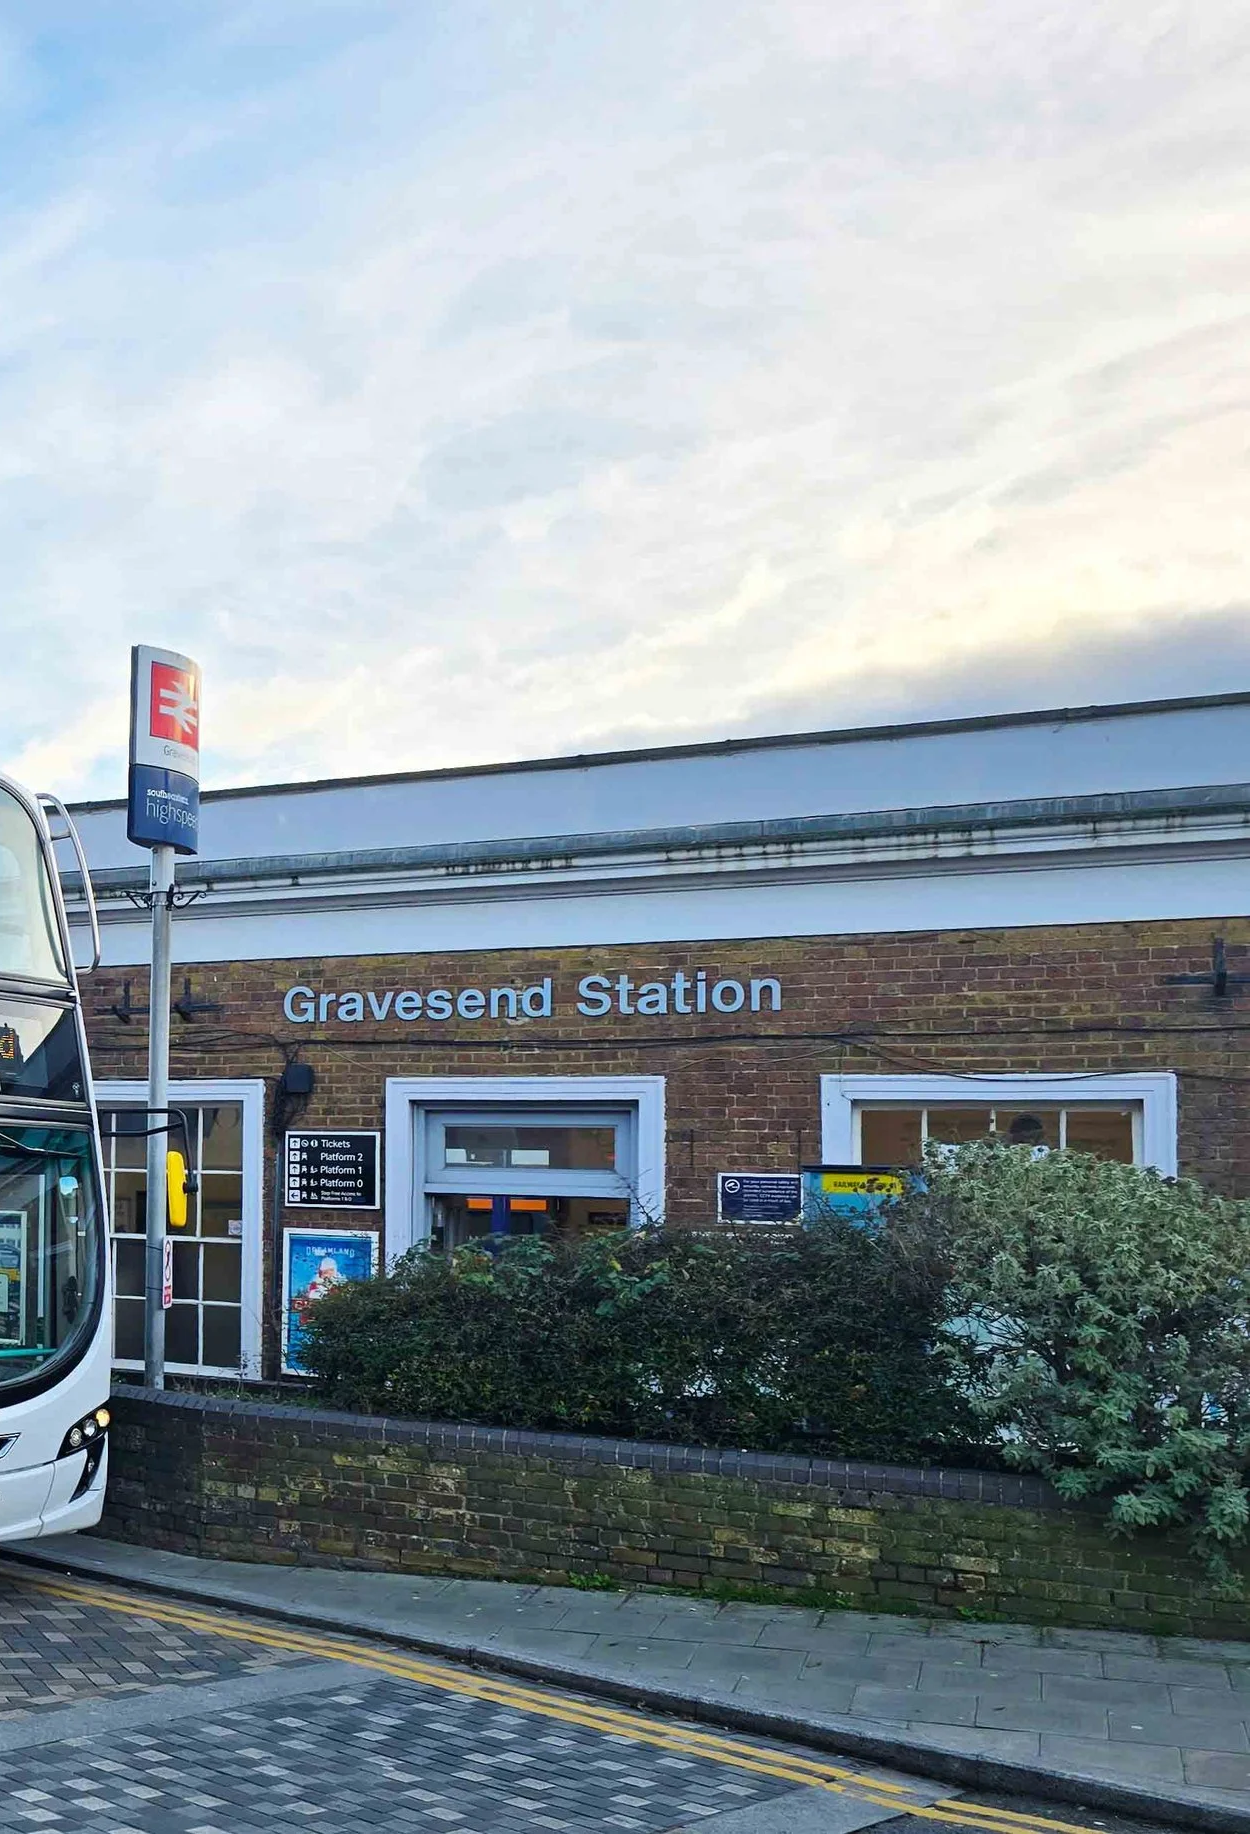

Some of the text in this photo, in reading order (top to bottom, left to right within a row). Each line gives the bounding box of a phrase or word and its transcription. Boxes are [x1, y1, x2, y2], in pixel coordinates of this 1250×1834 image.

[283, 967, 783, 1023] Gravesend Station
[321, 1140, 351, 1148] Tickets
[320, 1152, 363, 1161] Platform 2
[320, 1165, 362, 1174] Platform 1
[320, 1179, 363, 1188] Platform 0
